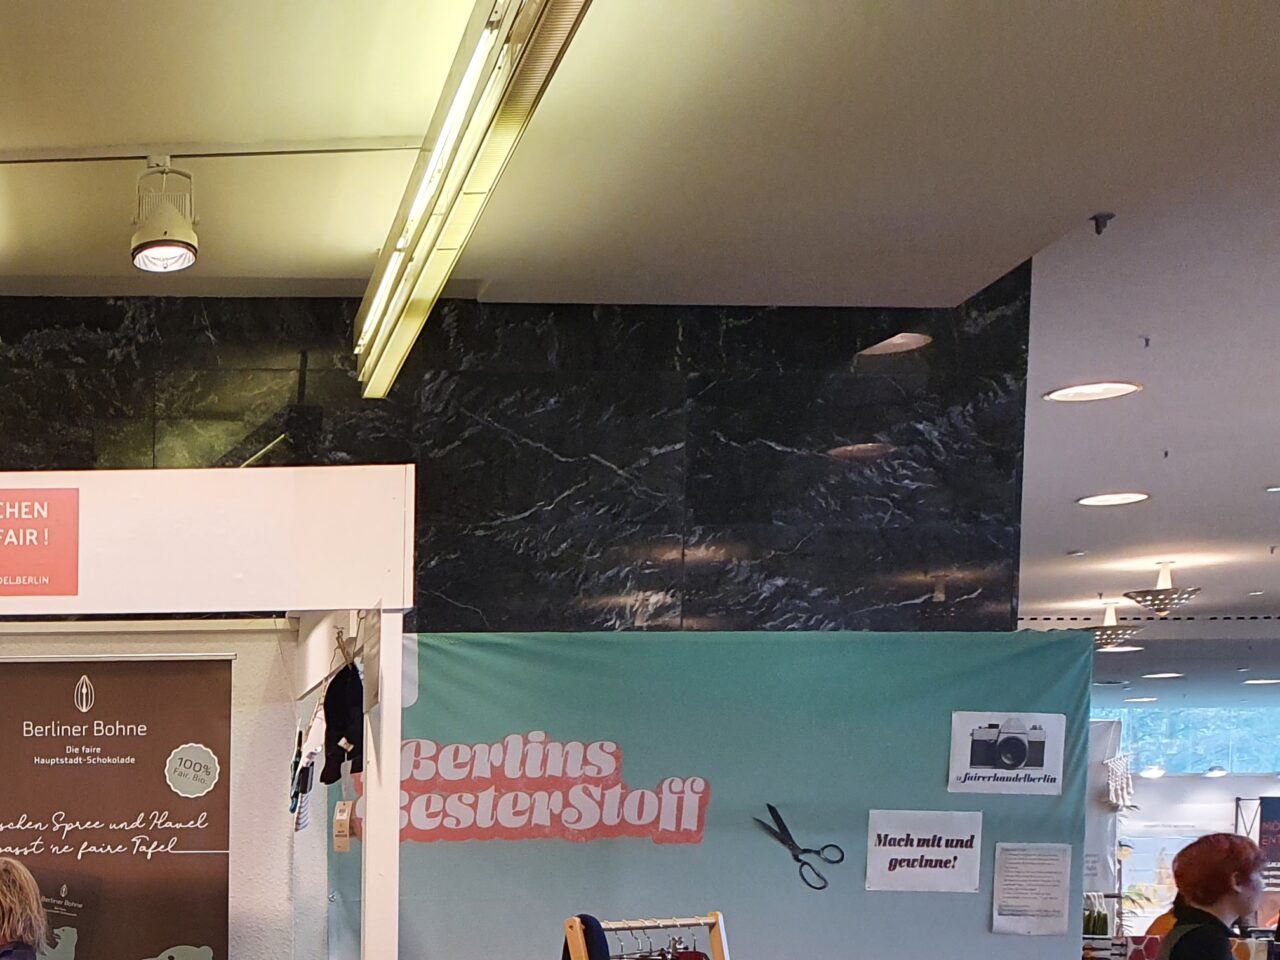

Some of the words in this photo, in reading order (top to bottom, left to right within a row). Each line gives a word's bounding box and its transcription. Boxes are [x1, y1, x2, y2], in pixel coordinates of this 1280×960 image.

[22, 721, 88, 737] Berliner
[93, 720, 147, 736] Bohne
[65, 745, 79, 754] Die
[82, 745, 101, 754] faire
[401, 730, 617, 781] Berlins
[33, 756, 136, 766] Hauptstadt-Schokolade
[176, 757, 212, 777] 100%
[52, 811, 104, 839] Spree
[109, 815, 145, 830] und
[149, 811, 208, 831] Havel
[77, 841, 128, 860] faire
[131, 835, 178, 860] Tafel
[875, 833, 914, 848] Mach
[916, 835, 942, 848] mit
[945, 835, 975, 849] und
[888, 856, 958, 872] gewinne!
